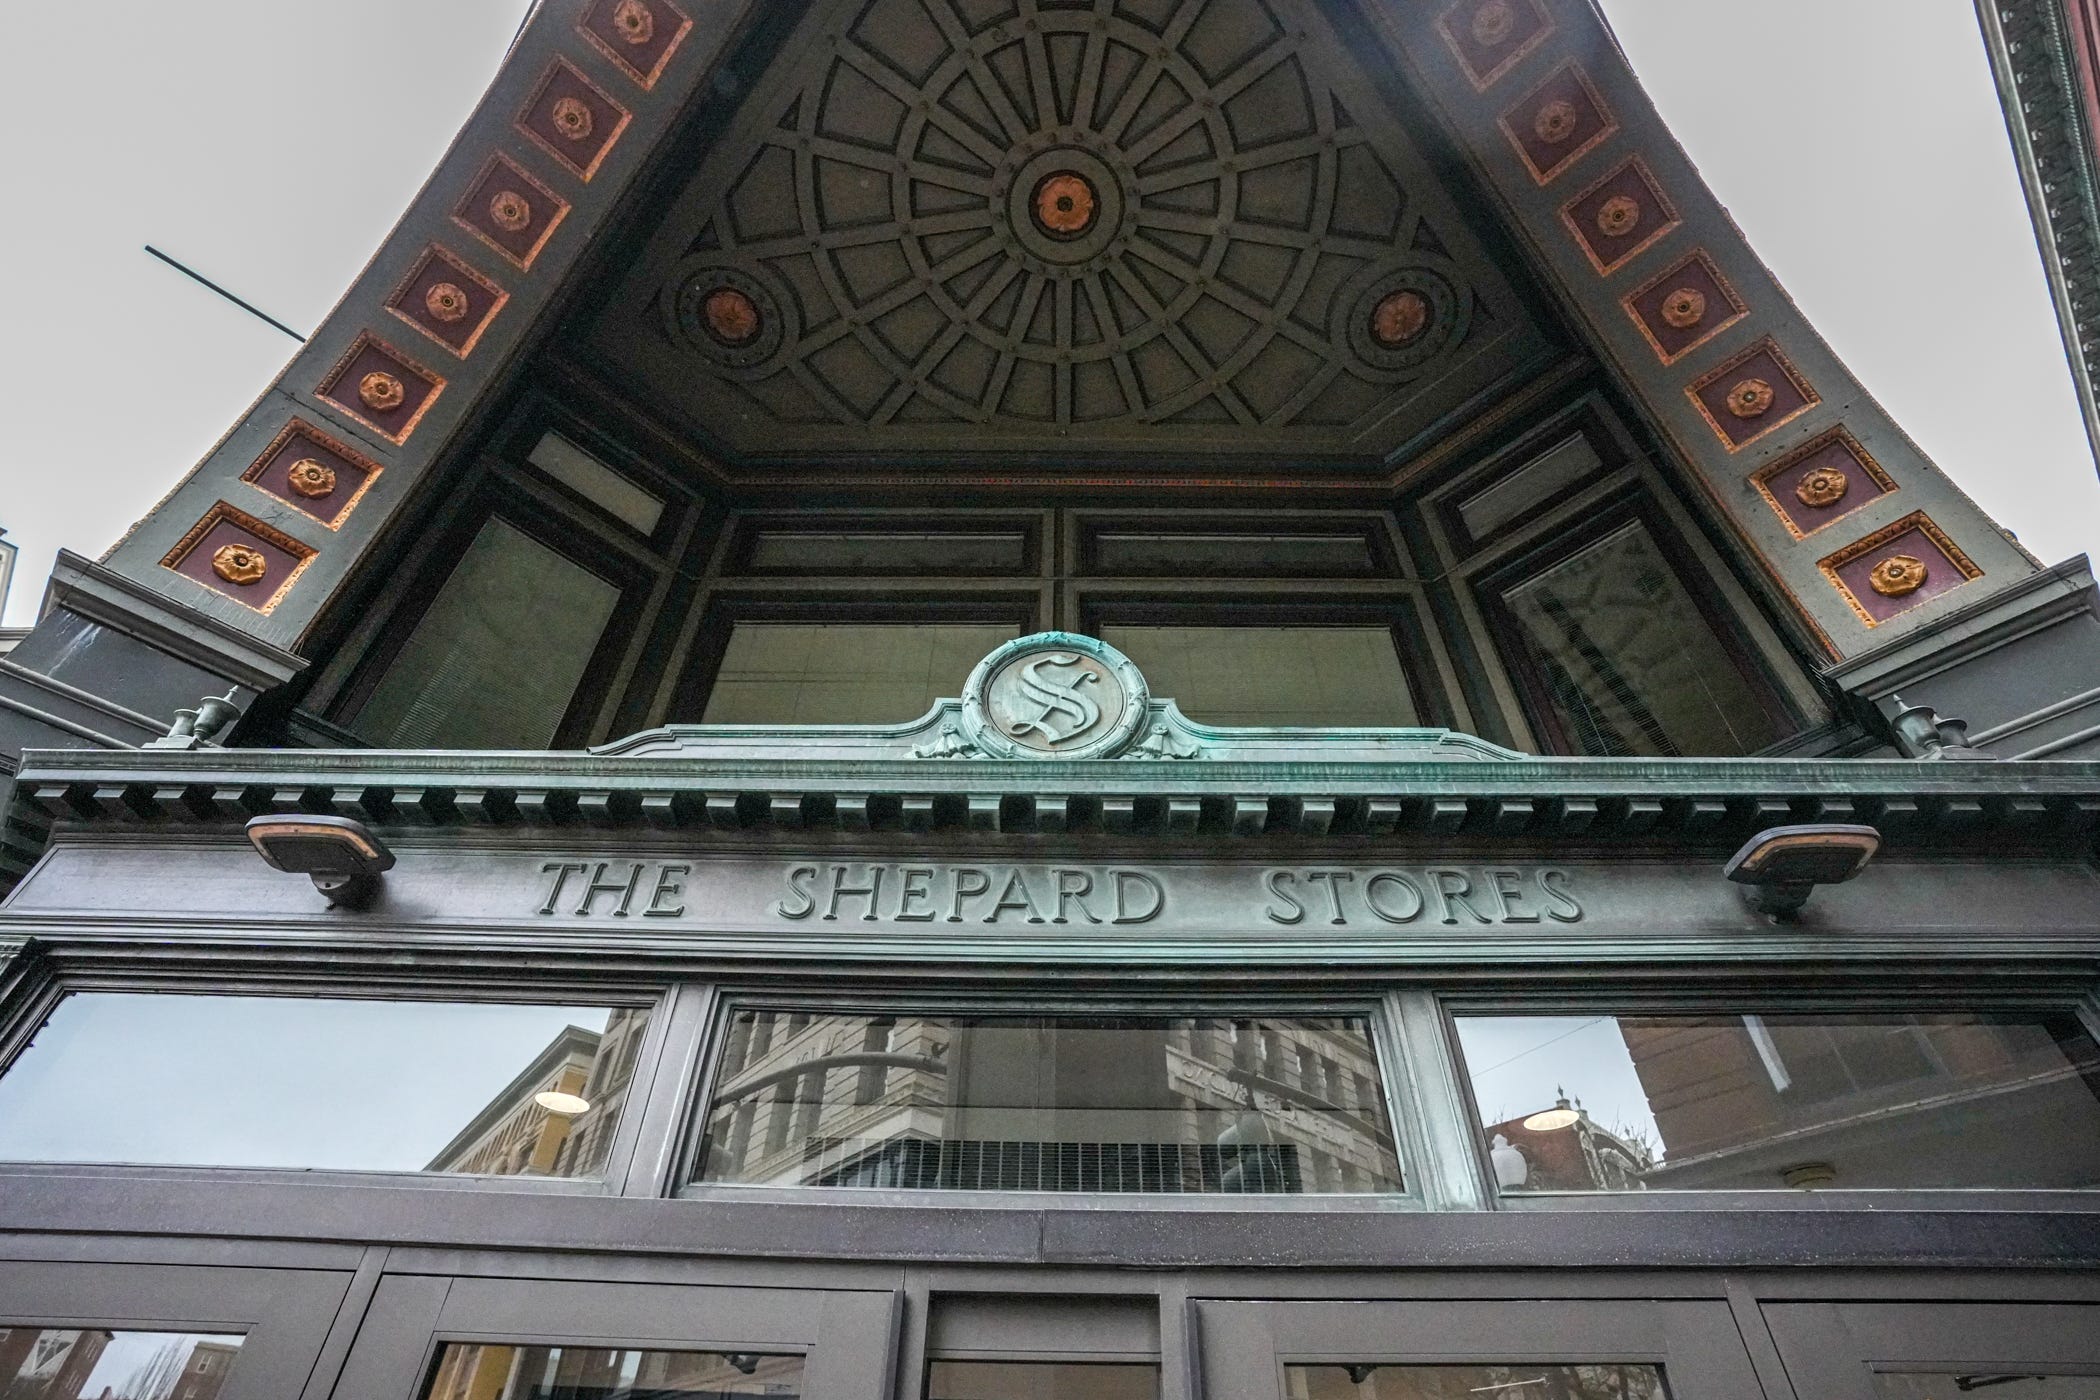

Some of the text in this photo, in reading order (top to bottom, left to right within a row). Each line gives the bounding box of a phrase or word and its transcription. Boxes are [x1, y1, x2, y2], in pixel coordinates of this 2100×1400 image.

[1010, 655, 1099, 745] S
[539, 862, 1583, 924] THE SHEPARD STORES
